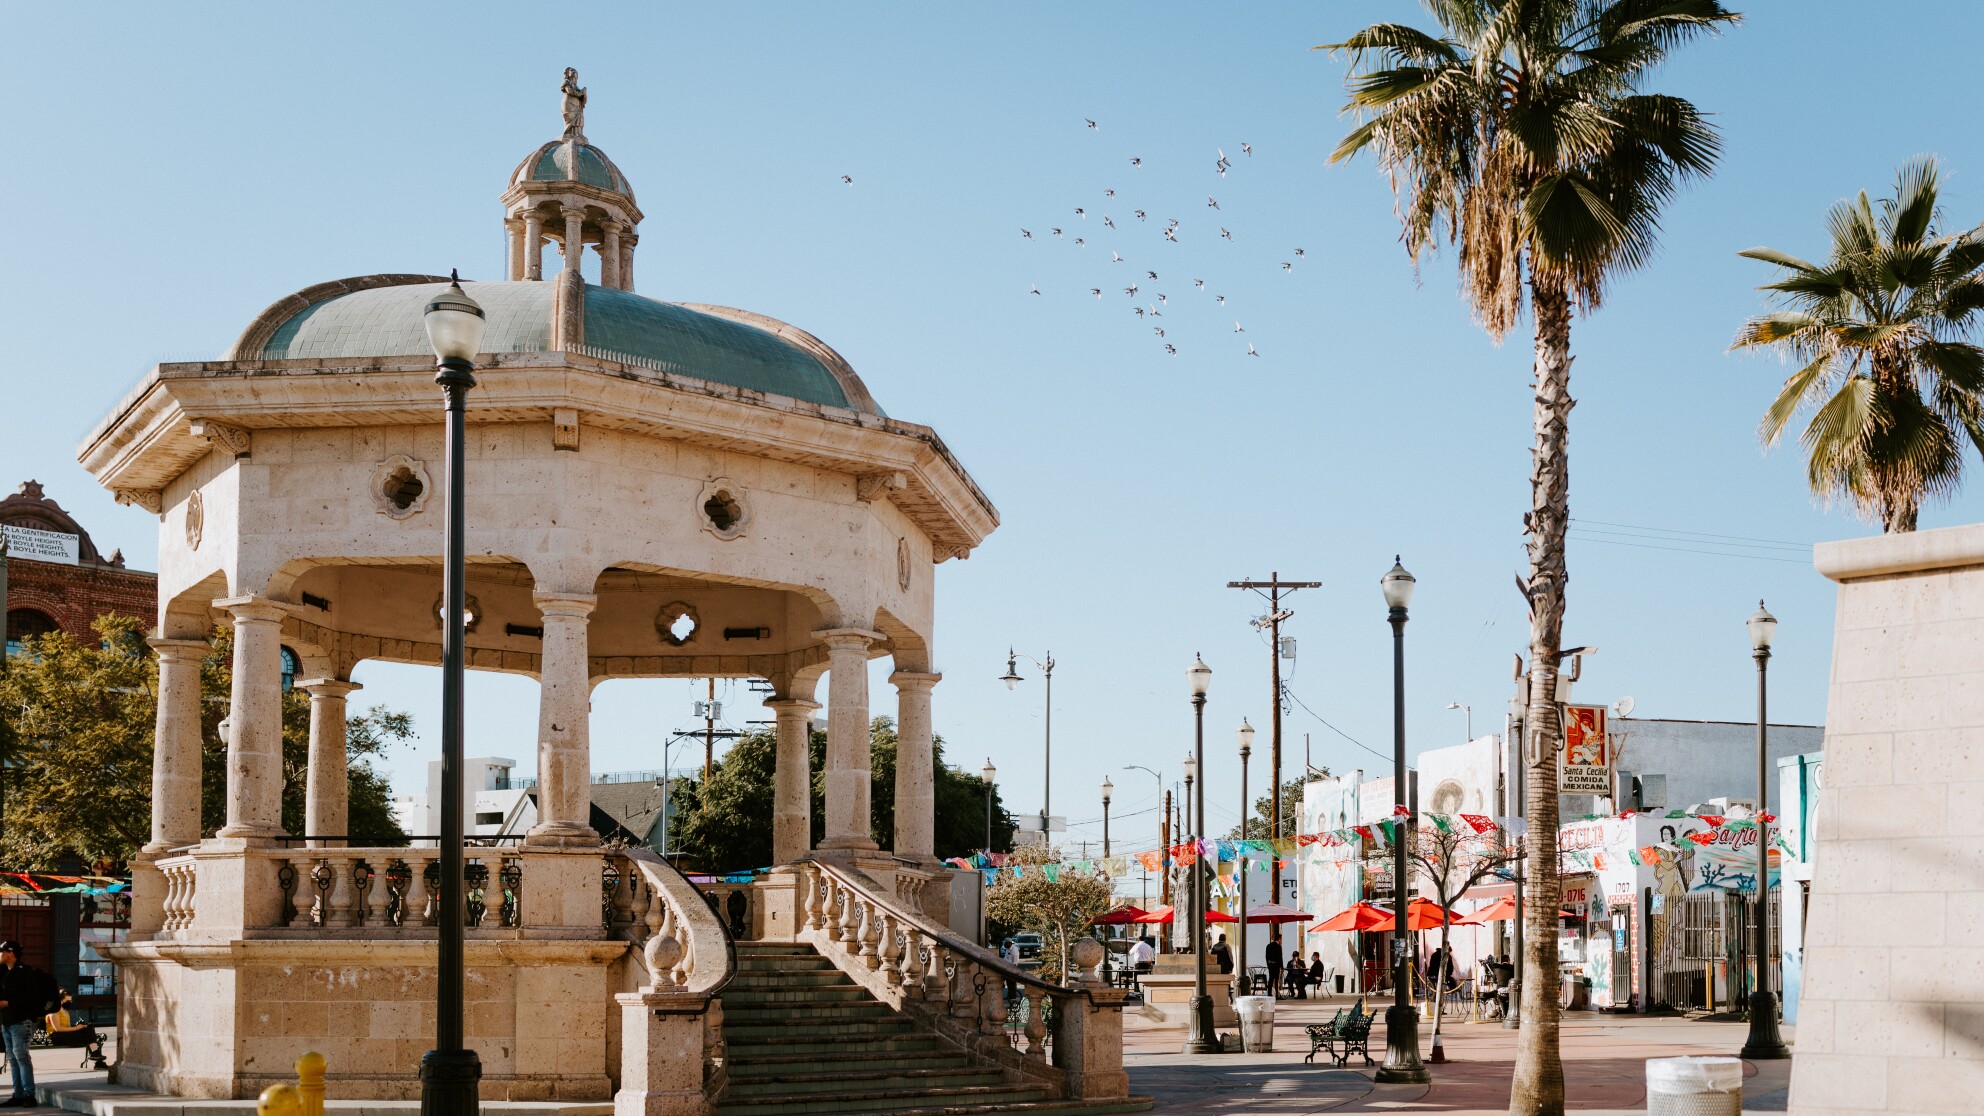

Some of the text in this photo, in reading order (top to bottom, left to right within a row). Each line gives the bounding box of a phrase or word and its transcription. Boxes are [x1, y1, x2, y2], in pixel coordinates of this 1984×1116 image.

[21, 529, 78, 541] GENTRIFICACION
[13, 546, 37, 554] BOYLE
[1560, 825, 1604, 849] CECILIA
[1282, 879, 1297, 888] ET
[1616, 882, 1630, 893] 1707
